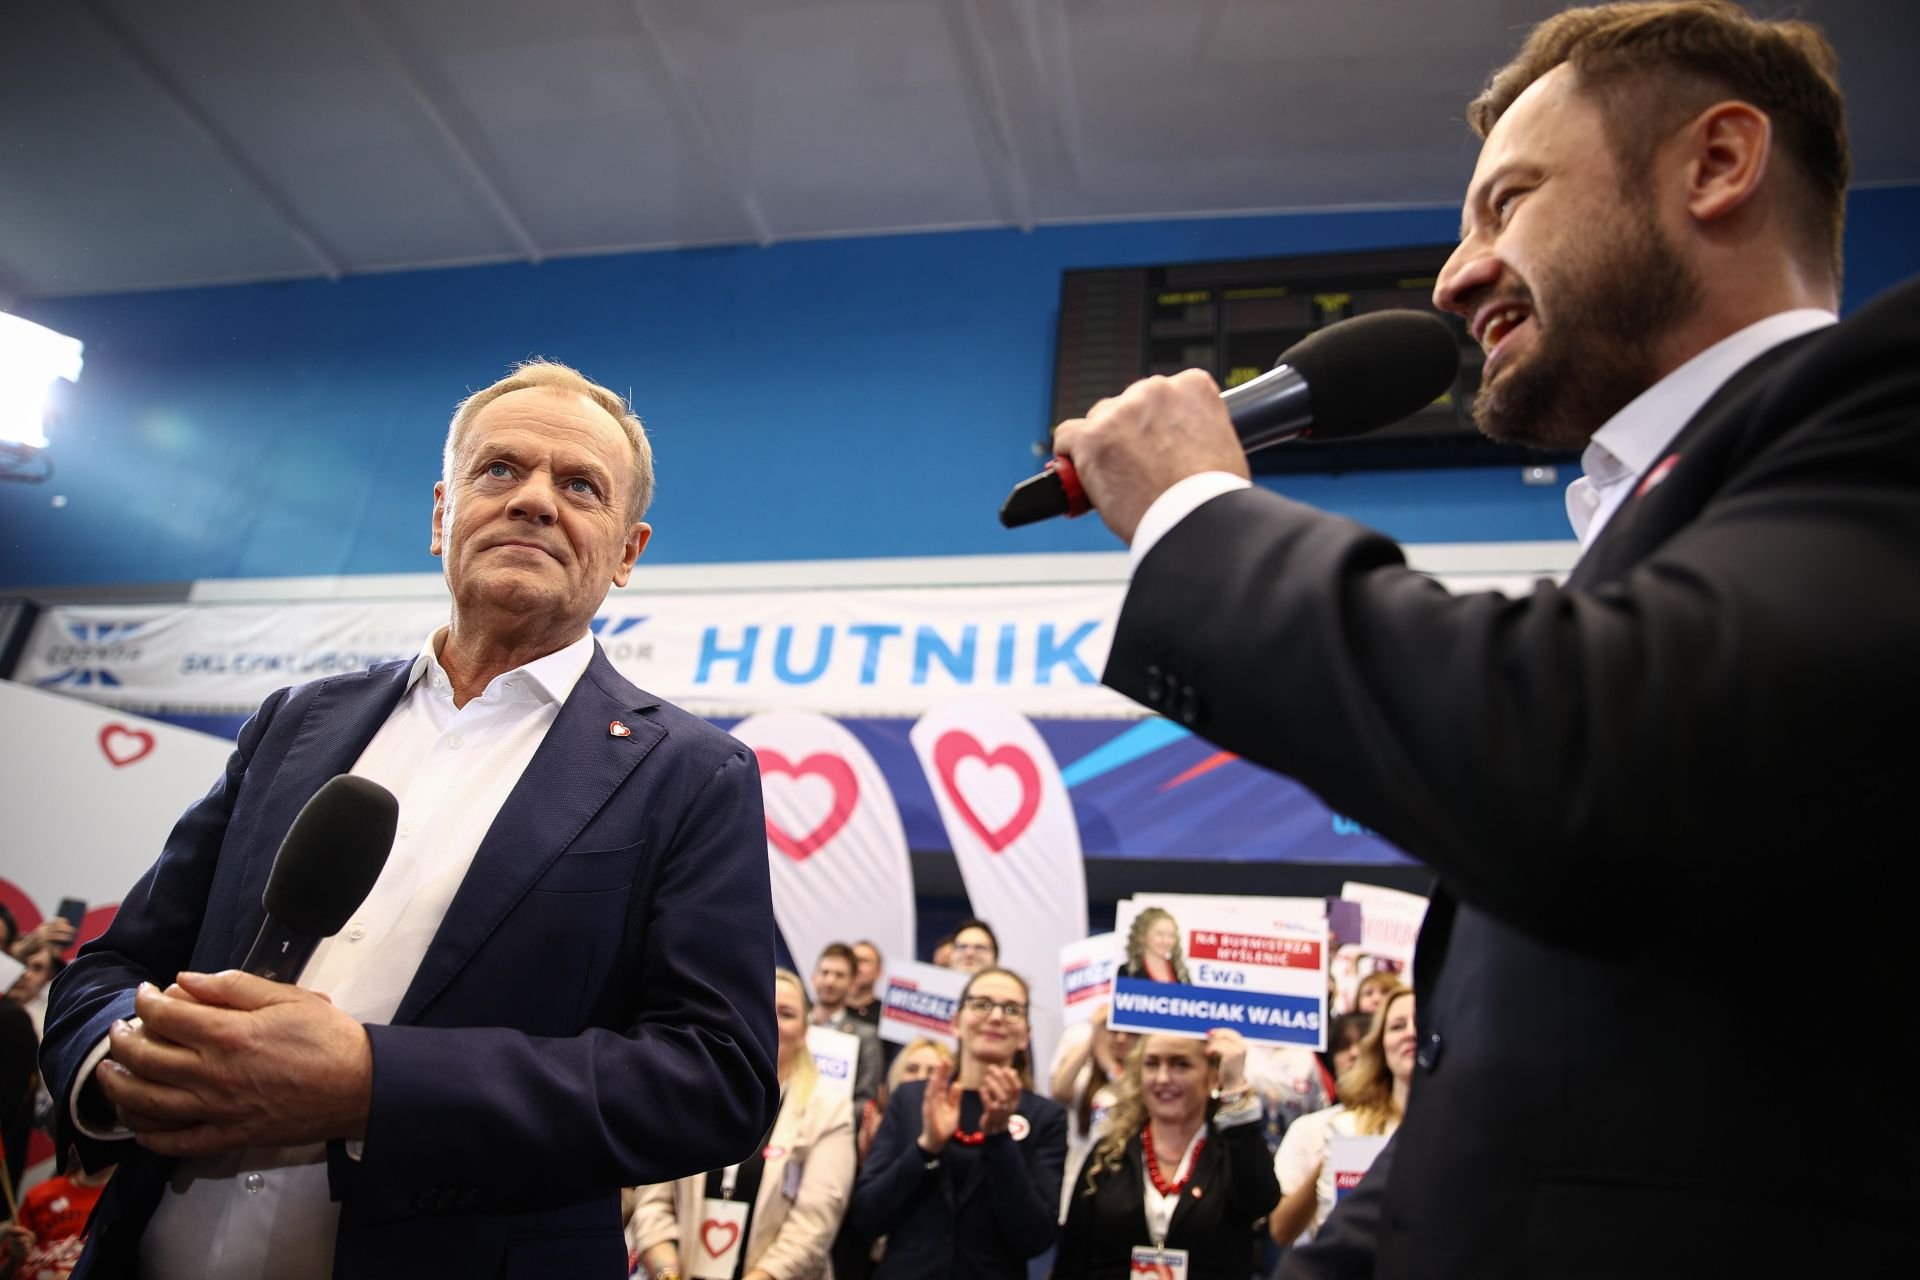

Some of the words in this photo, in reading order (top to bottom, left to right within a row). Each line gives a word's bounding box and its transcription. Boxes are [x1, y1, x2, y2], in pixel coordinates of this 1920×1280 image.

[694, 619, 1103, 686] HUTNIK
[281, 940, 290, 953] 1
[1195, 932, 1217, 946] NA
[1220, 935, 1312, 955] BURMISTRZA
[1198, 964, 1245, 985] Ewa
[1114, 992, 1244, 1024] WINCENCIAK
[1246, 1005, 1320, 1031] WALAS
